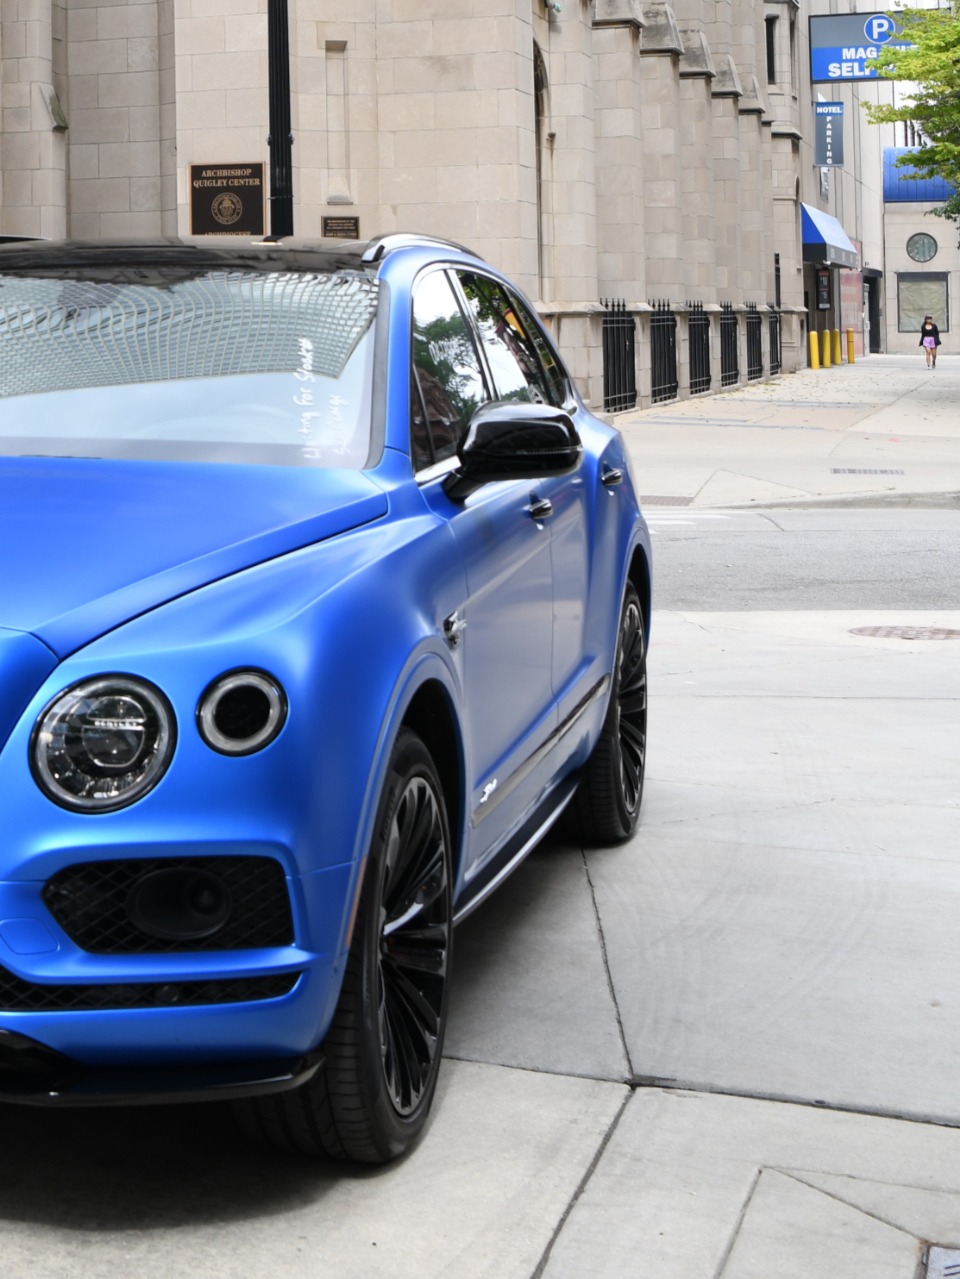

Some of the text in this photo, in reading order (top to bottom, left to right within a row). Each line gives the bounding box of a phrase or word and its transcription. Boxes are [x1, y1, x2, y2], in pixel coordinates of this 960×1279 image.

[872, 19, 889, 39] P
[842, 47, 878, 60] MAG
[816, 106, 842, 114] HOTEL
[201, 168, 252, 177] ARCHBISHOP
[193, 178, 261, 188] QUIGLEY CENTER
